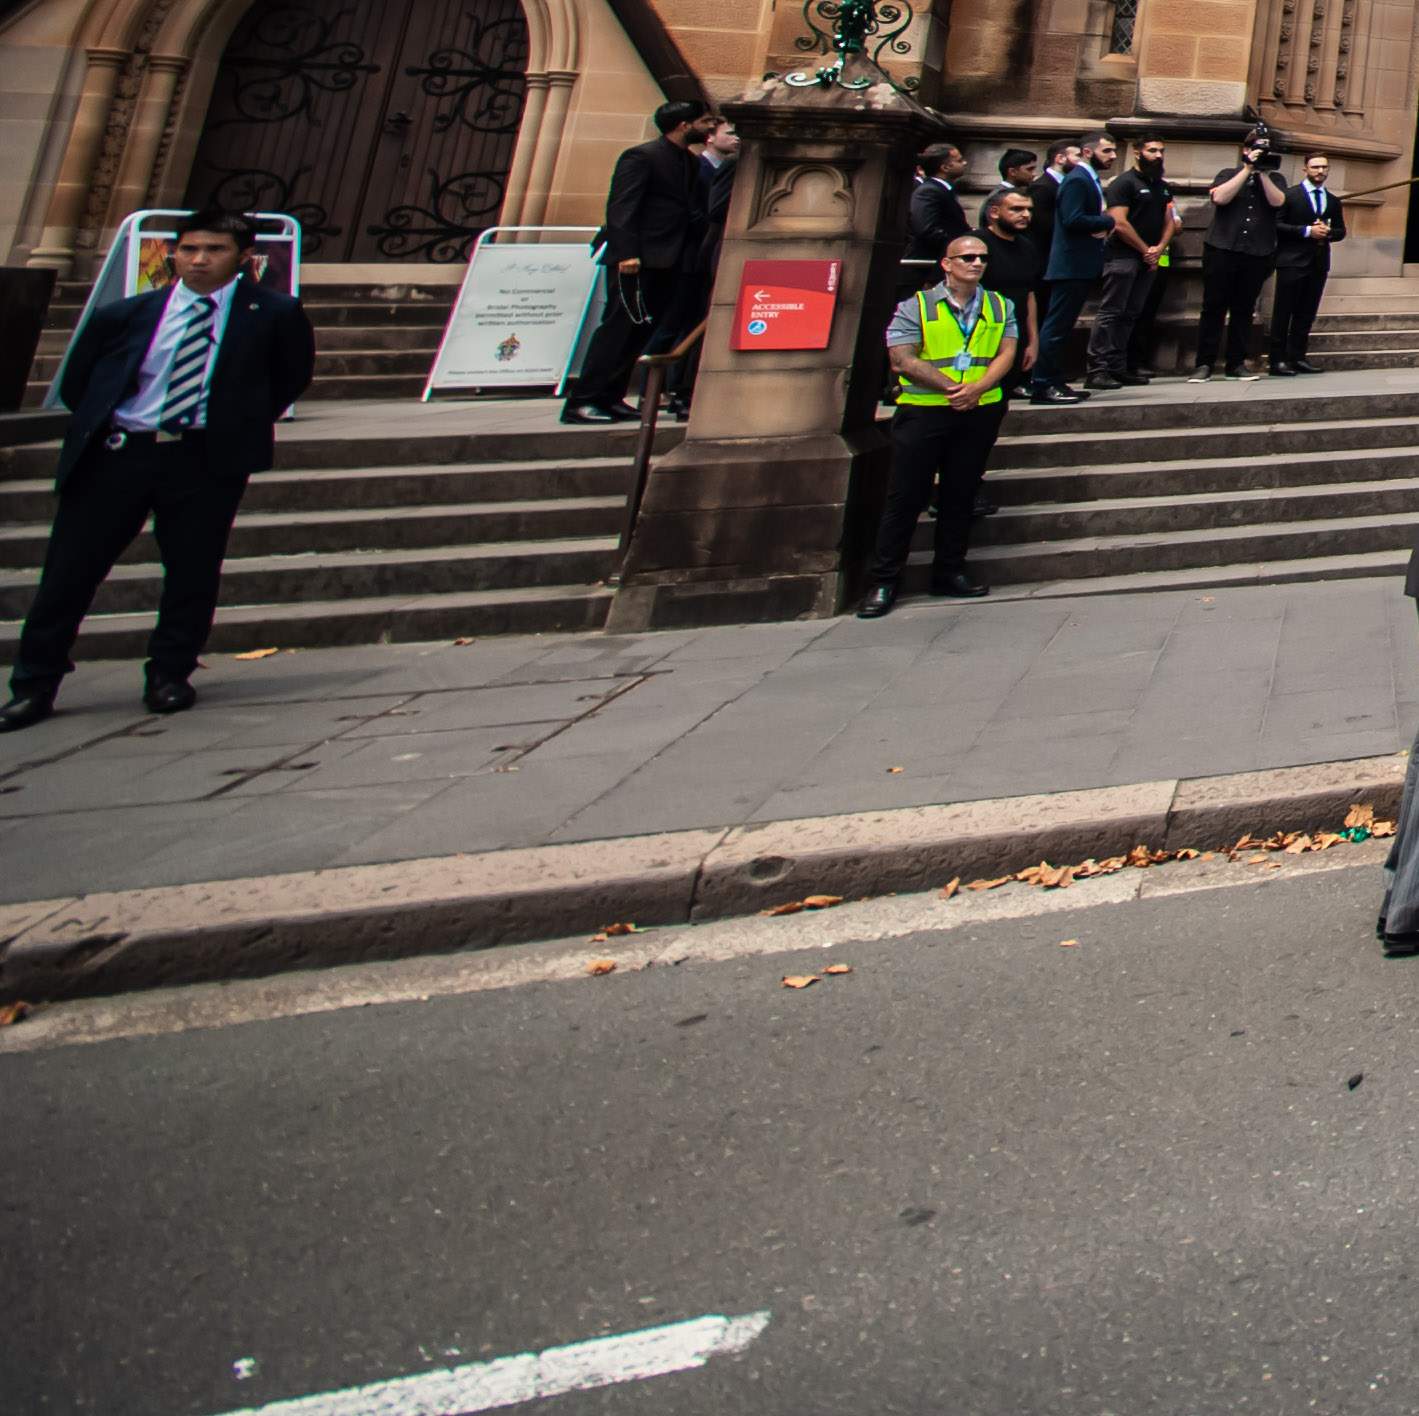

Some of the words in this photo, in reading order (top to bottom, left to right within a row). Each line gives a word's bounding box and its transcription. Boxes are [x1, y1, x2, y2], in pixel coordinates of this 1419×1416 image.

[512, 287, 556, 295] Commercial
[510, 303, 557, 311] Photography
[751, 303, 805, 311] ACCESSIBLE
[750, 311, 780, 319] ENTRY
